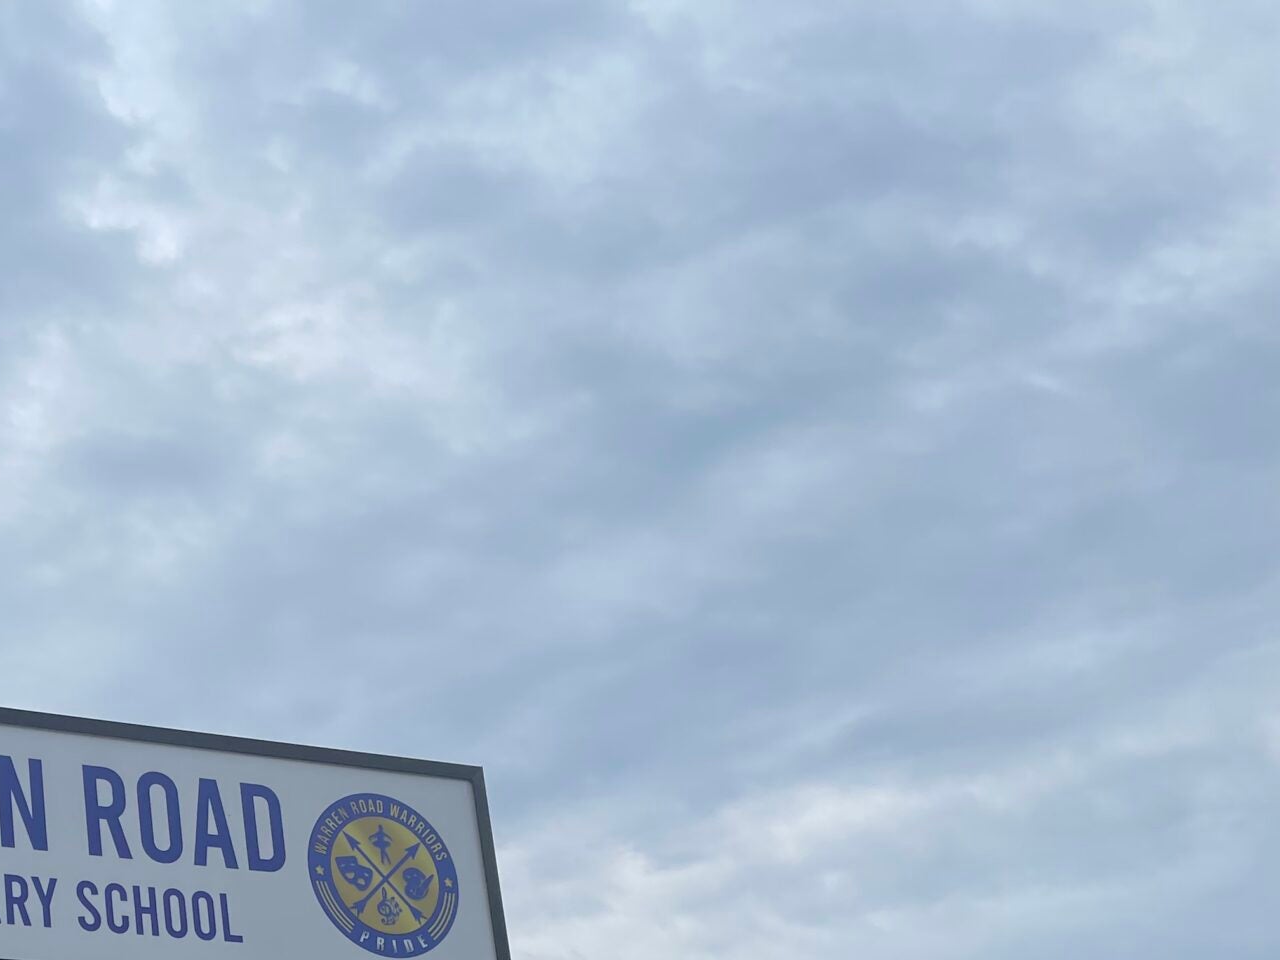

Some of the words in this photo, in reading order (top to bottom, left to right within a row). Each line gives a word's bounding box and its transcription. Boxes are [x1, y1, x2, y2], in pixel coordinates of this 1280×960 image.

[82, 764, 286, 872] ROAD
[314, 807, 349, 855] WARREN
[350, 799, 384, 815] ROAD
[390, 803, 447, 861] WARRIORS
[76, 880, 243, 943] SCHOOL
[360, 930, 428, 953] PRIDE
